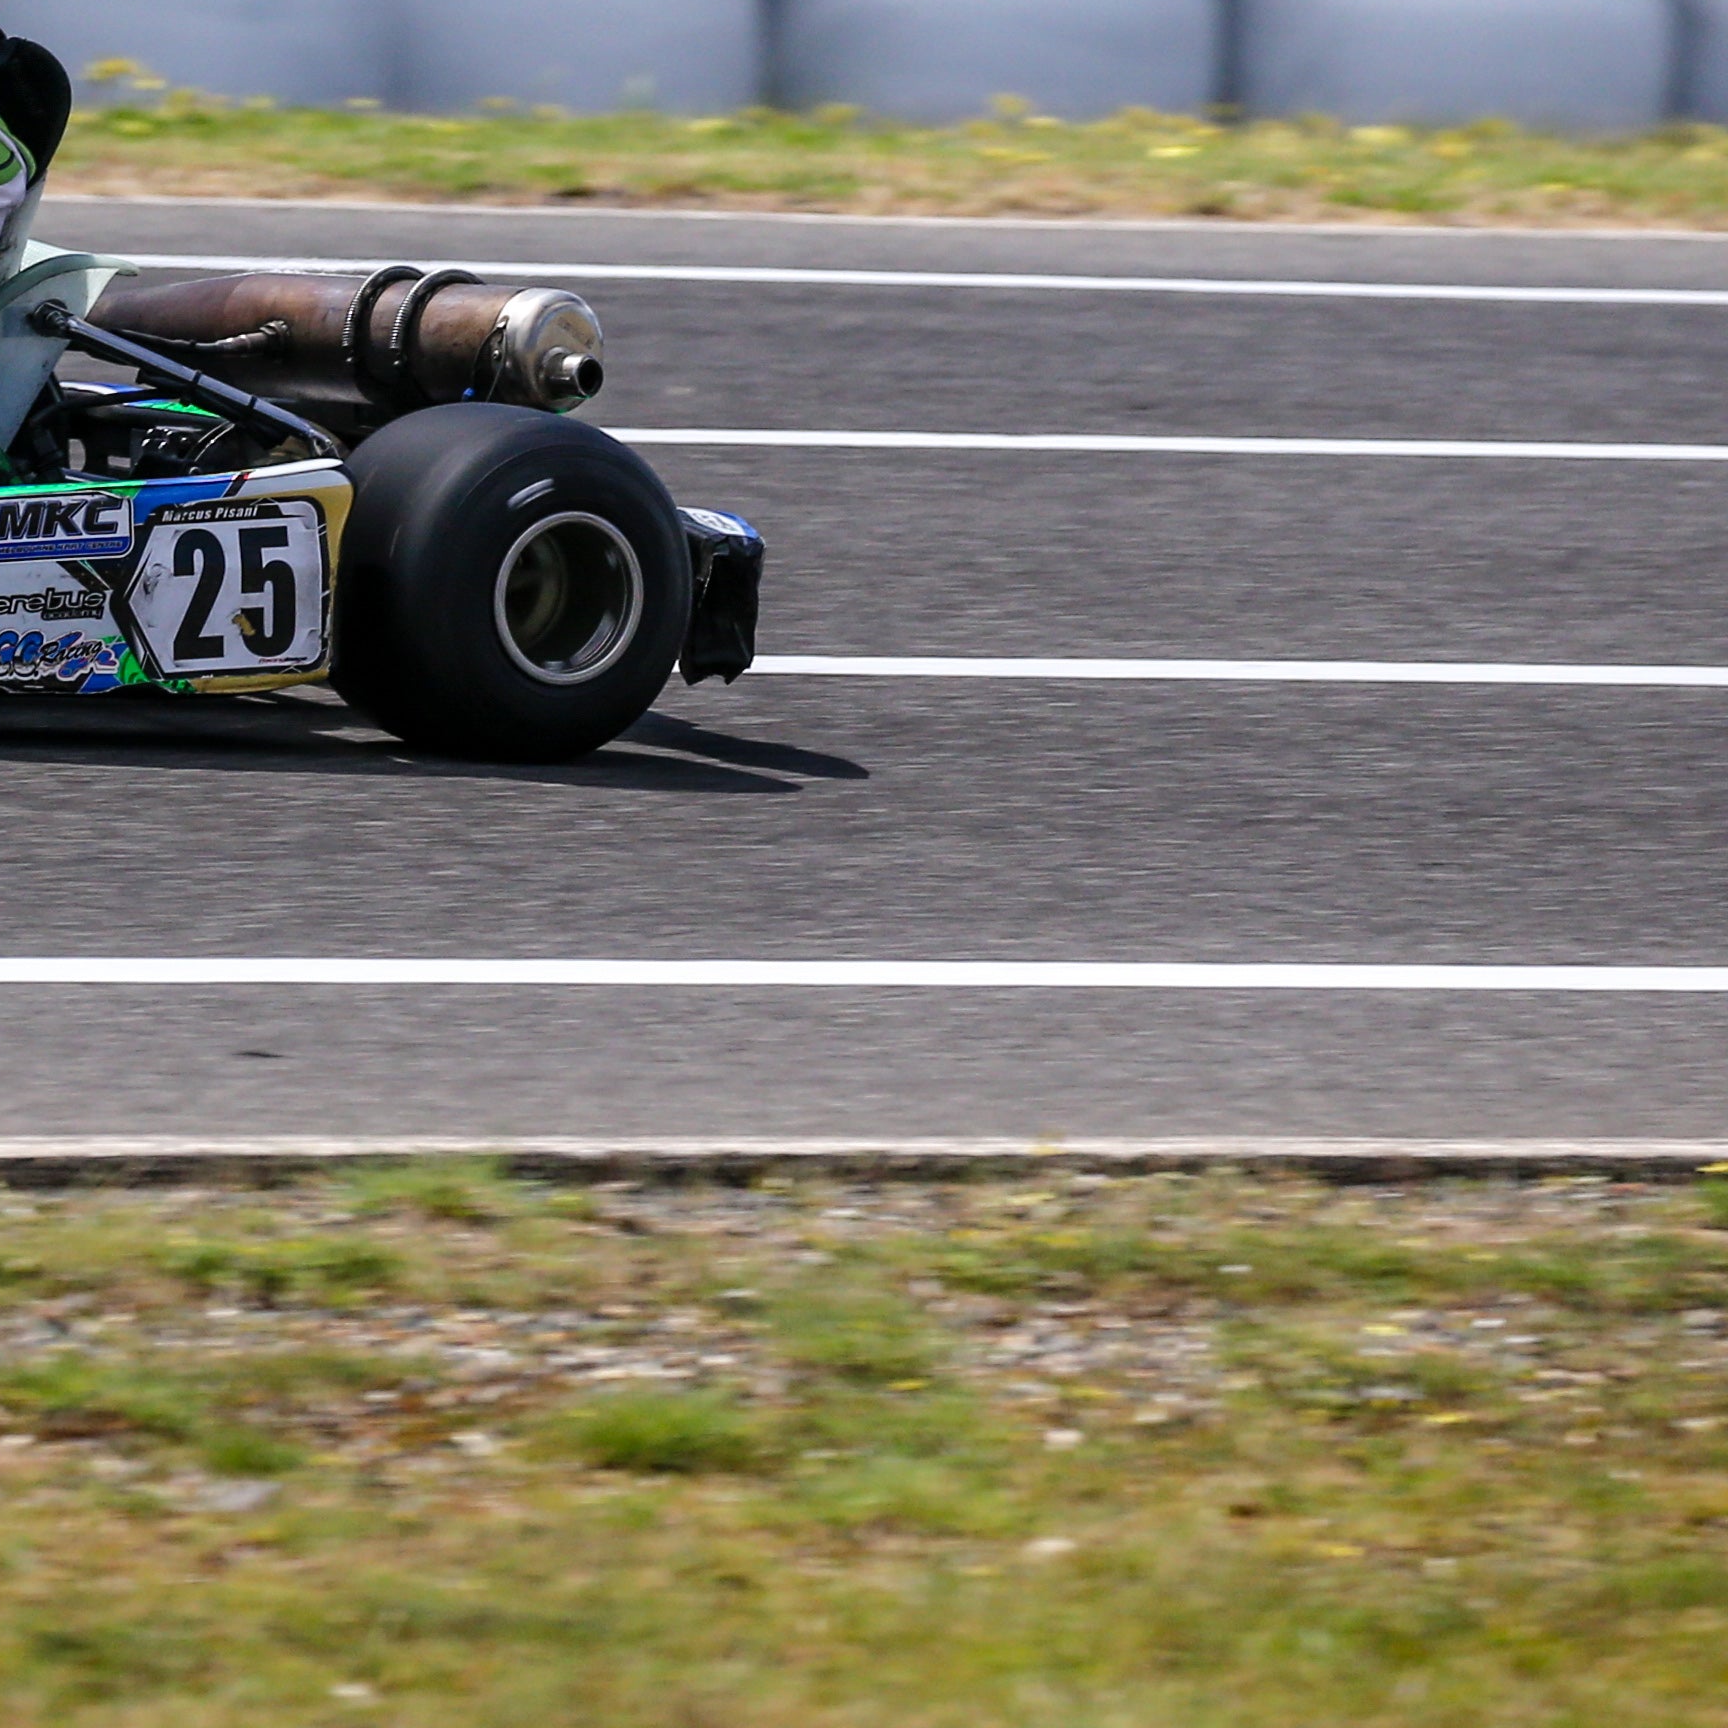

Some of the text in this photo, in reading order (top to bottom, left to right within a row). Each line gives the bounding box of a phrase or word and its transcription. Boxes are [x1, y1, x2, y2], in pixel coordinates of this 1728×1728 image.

[162, 506, 258, 522] Marcus Pisani
[173, 525, 296, 660] 25
[39, 639, 104, 665] Racing
